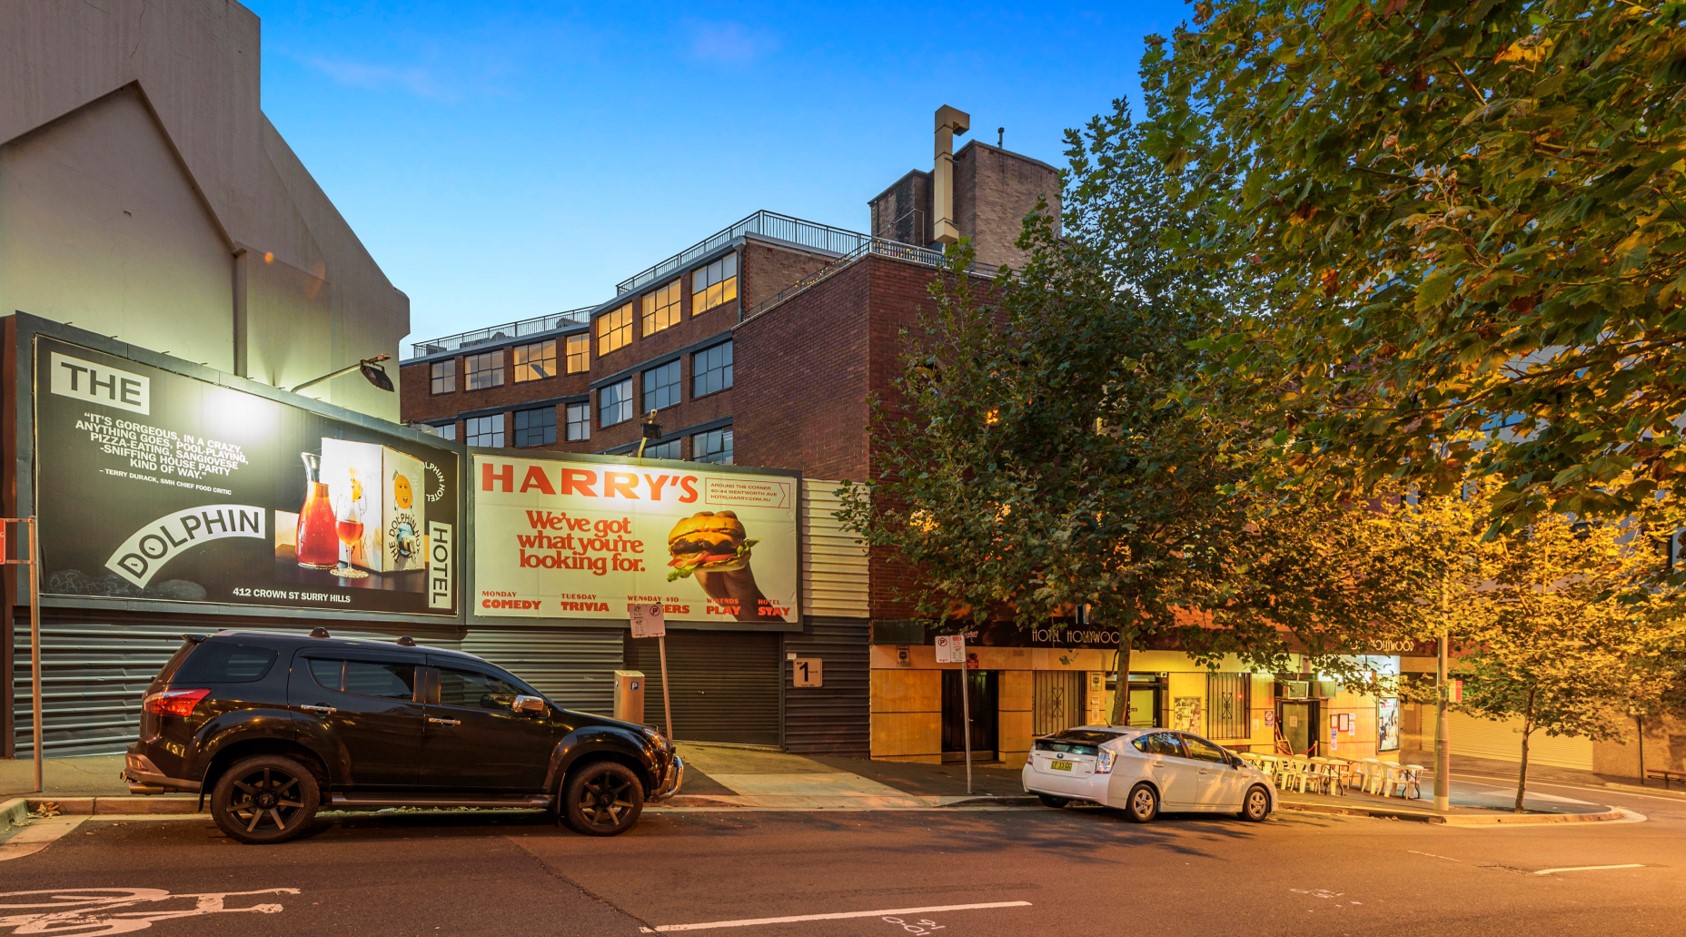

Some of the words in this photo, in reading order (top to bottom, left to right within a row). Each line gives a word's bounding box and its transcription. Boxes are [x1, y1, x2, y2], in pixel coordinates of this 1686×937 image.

[61, 361, 141, 407] THE
[75, 420, 136, 440] ANYTHING
[141, 434, 173, 449] GOES,
[176, 441, 248, 465] POOL-PLAYING,
[116, 419, 180, 442] GORGEOUS,
[184, 434, 194, 444] IN
[197, 437, 204, 446] A
[207, 440, 242, 455] CRAZY,
[91, 432, 172, 457] PIZZA-EATING,
[176, 450, 238, 470] SANGIOVESE
[100, 444, 156, 462] -SNIFFING
[160, 455, 195, 470] HOUSE
[199, 463, 231, 476] PARTY
[130, 458, 157, 471] KIND
[160, 464, 175, 474] OF
[105, 468, 128, 478] TERRY
[129, 472, 159, 484] DURACK,
[160, 478, 175, 486] SMH
[176, 481, 195, 489] CHIEF
[196, 484, 212, 492] FOOD
[213, 487, 232, 496] CRITIC
[426, 484, 445, 502] HOTEL
[482, 463, 698, 504] HARRY'S
[389, 513, 417, 537] DOLPHIN
[526, 510, 591, 533] We've
[594, 517, 631, 538] got
[117, 509, 260, 579] DOLPHIN
[389, 541, 400, 563] THE
[517, 530, 575, 551] what
[578, 534, 644, 556] you're
[433, 527, 448, 604] HOTEL
[519, 549, 607, 576] looking
[612, 552, 646, 572] for.
[233, 587, 251, 597] 412
[253, 589, 287, 599] CROWN
[288, 591, 299, 600] ST
[301, 592, 328, 602] SURRY
[330, 594, 351, 603] HILLS
[482, 599, 542, 610] COMEDY
[561, 601, 609, 612] TRIVIA
[706, 605, 741, 615] PLAY
[758, 606, 790, 616] STAY
[1032, 629, 1060, 642] HOTEL
[1067, 630, 1120, 644] HOLLYWOO
[799, 661, 808, 682] 1
